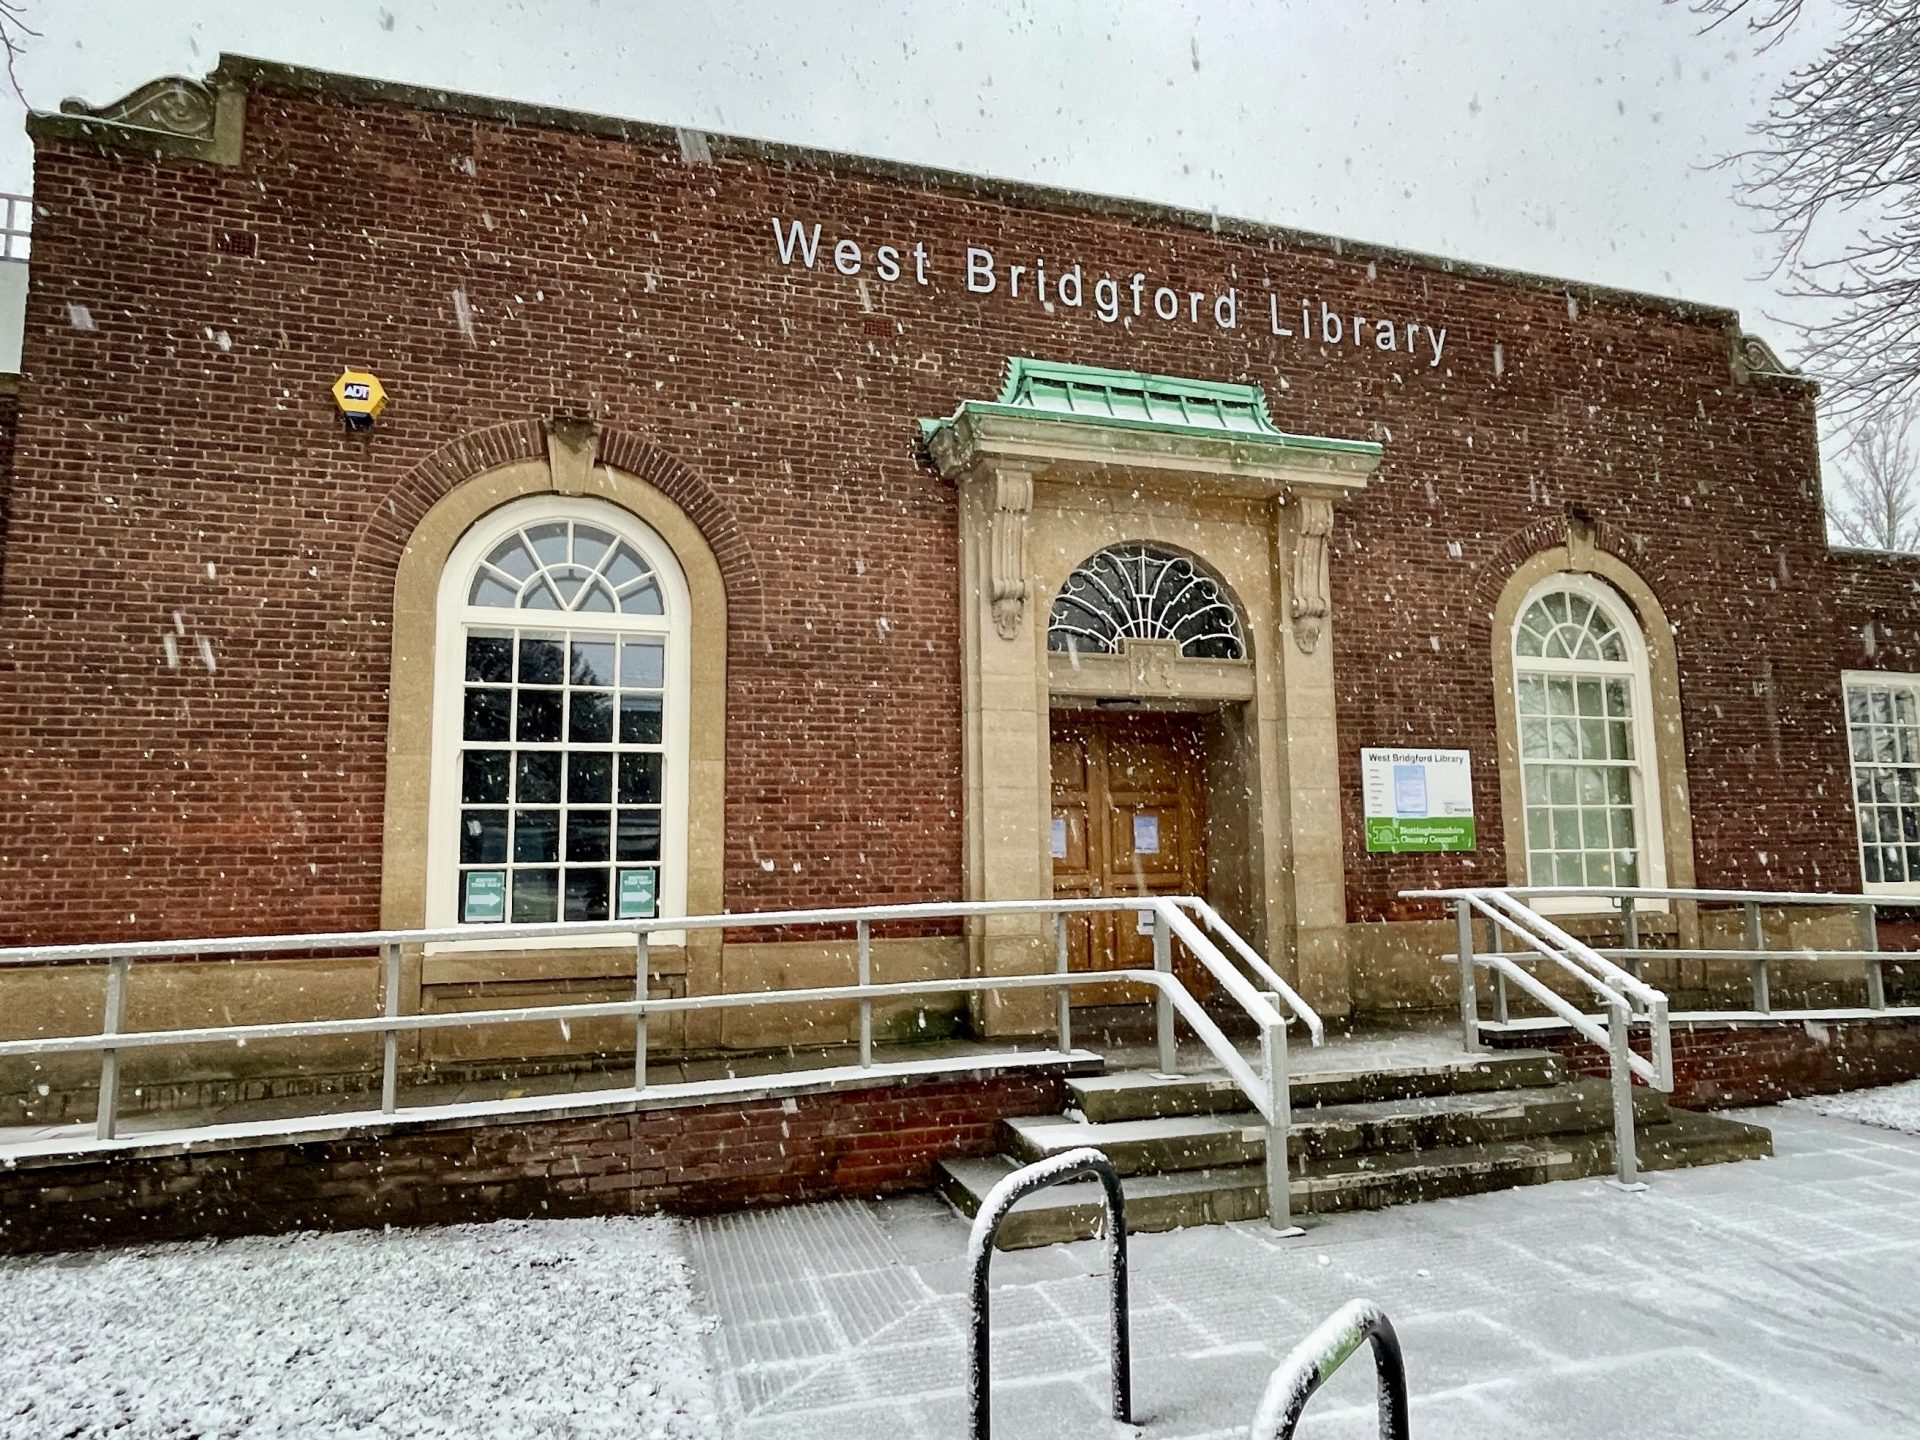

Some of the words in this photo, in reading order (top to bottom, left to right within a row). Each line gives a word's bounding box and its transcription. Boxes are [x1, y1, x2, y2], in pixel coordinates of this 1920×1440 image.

[772, 217, 928, 286] West
[966, 247, 1237, 330] Bridgford
[1270, 294, 1446, 367] Library
[344, 385, 370, 398] ADT
[1369, 753, 1390, 762] West
[1392, 753, 1433, 764] Bridgford
[1434, 754, 1463, 765] Library
